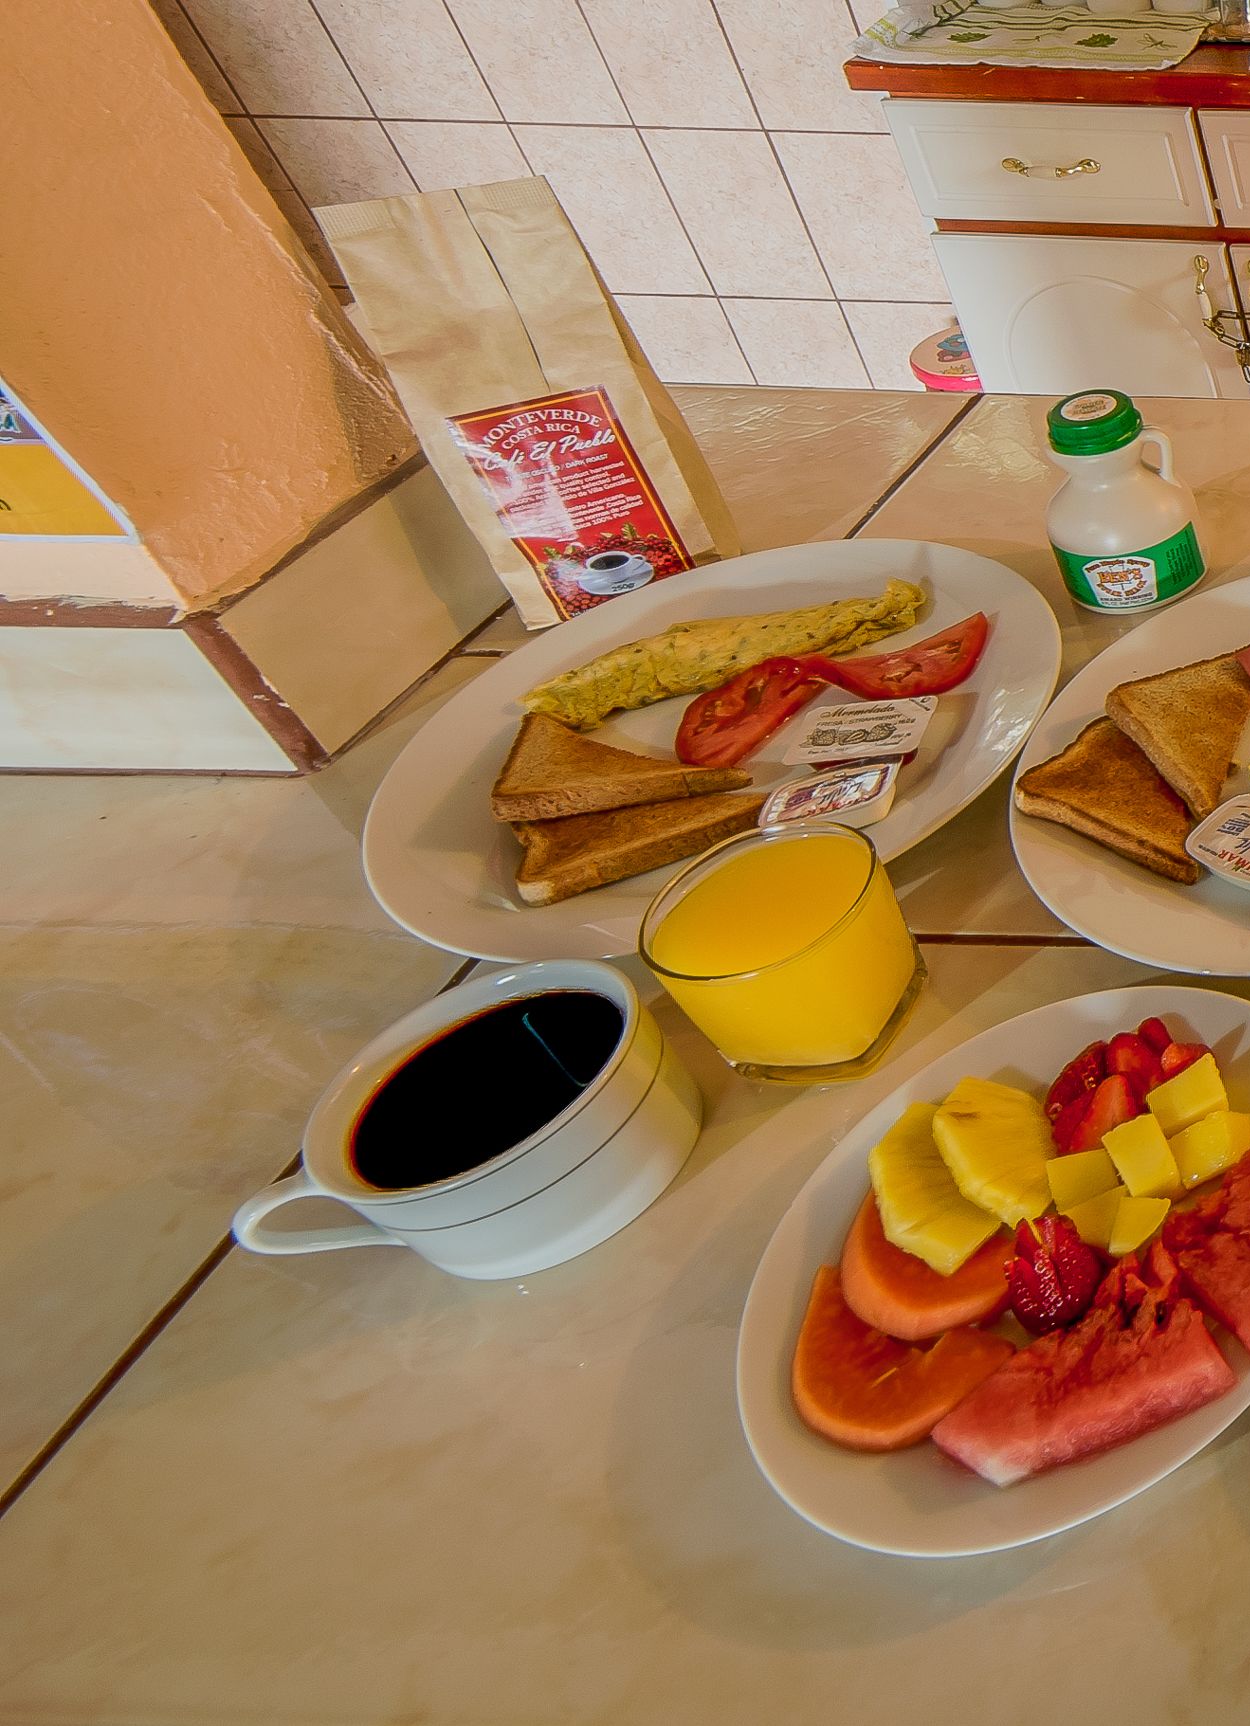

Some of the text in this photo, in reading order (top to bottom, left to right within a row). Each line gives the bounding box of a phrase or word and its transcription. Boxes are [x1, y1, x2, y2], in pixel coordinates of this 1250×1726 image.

[481, 409, 602, 450] MONTEVERDE
[501, 423, 580, 449] COSTA RICA
[530, 441, 556, 460] El
[559, 428, 615, 454] Pueblo
[562, 471, 589, 483] product
[590, 461, 624, 475] harvested
[565, 460, 585, 469] DARK
[586, 453, 608, 464] ROAST
